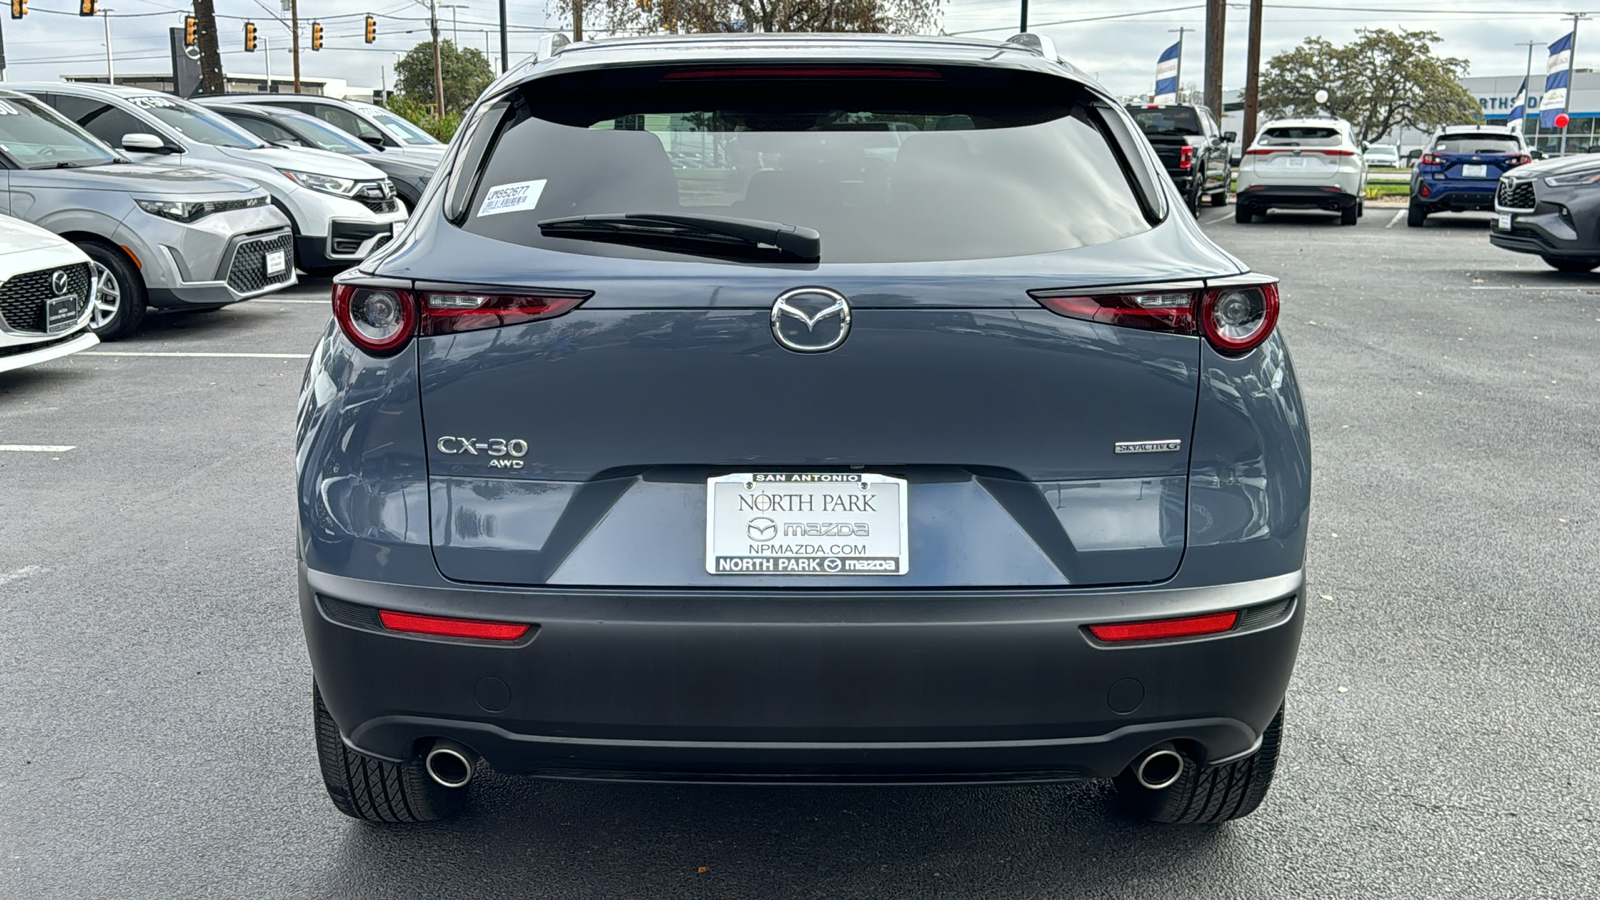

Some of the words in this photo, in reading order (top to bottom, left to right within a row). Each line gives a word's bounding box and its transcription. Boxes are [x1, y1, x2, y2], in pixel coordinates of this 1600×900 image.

[437, 435, 529, 458] CX-30
[487, 459, 524, 469] AWD
[756, 474, 786, 482] SAN
[791, 474, 859, 482] ANTONIO
[738, 490, 814, 514] NORTH
[822, 494, 877, 512] PARK
[749, 544, 866, 555] NPMAZDA.COM
[719, 558, 773, 571] NORTH
[778, 558, 820, 571] PARK
